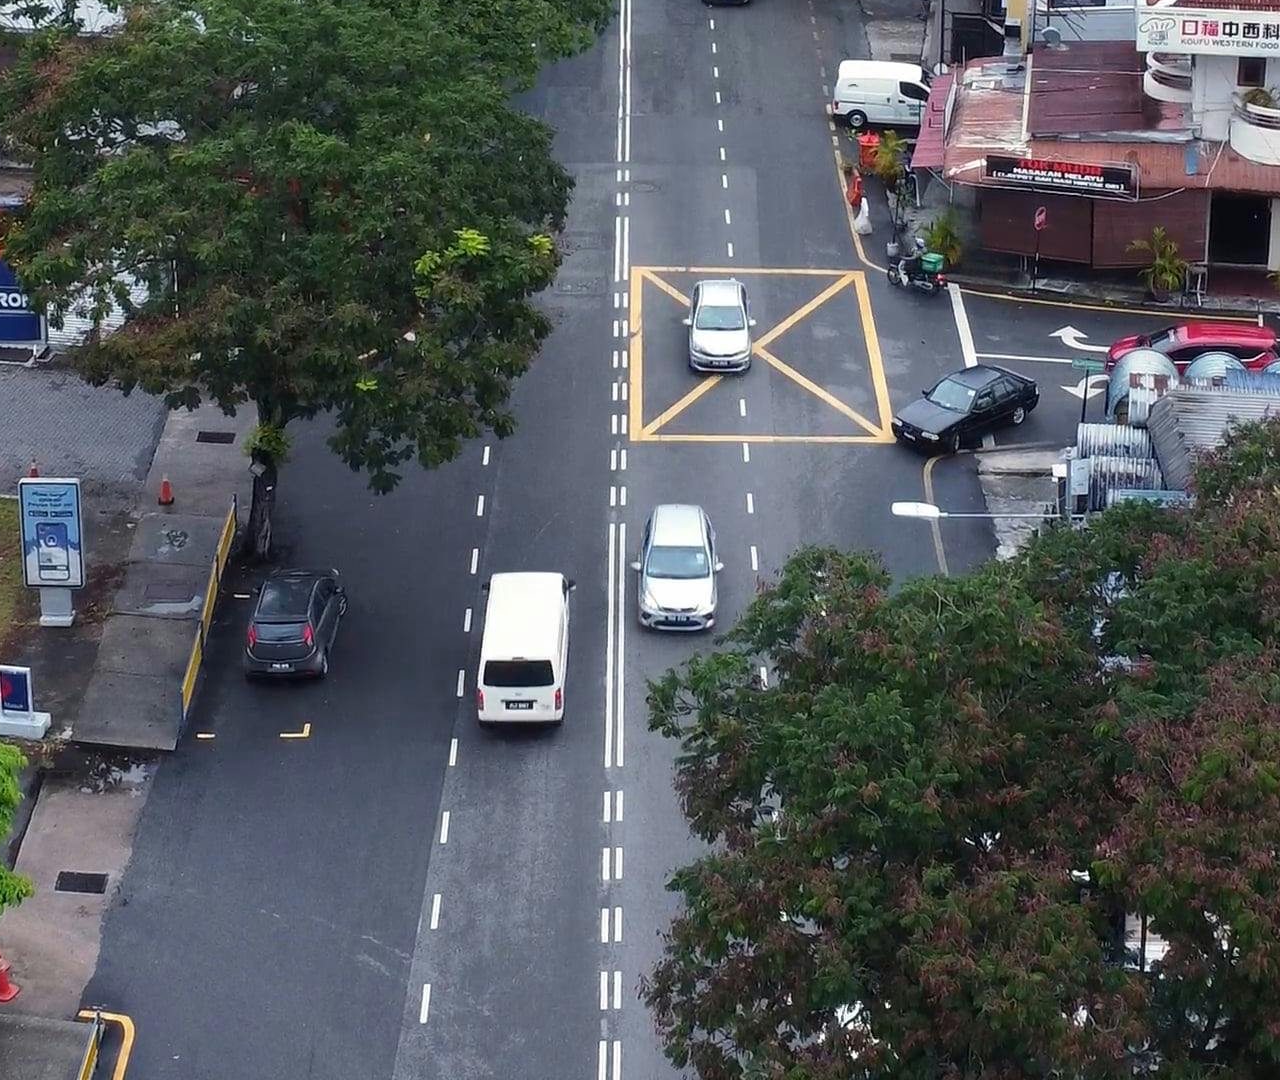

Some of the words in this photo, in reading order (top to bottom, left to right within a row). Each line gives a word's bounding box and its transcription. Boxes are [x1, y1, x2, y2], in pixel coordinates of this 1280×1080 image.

[1212, 39, 1254, 48] WESTERN
[1255, 41, 1279, 50] FOOD
[1012, 167, 1062, 178] MASAKAN
[1064, 172, 1104, 182] MELAYU
